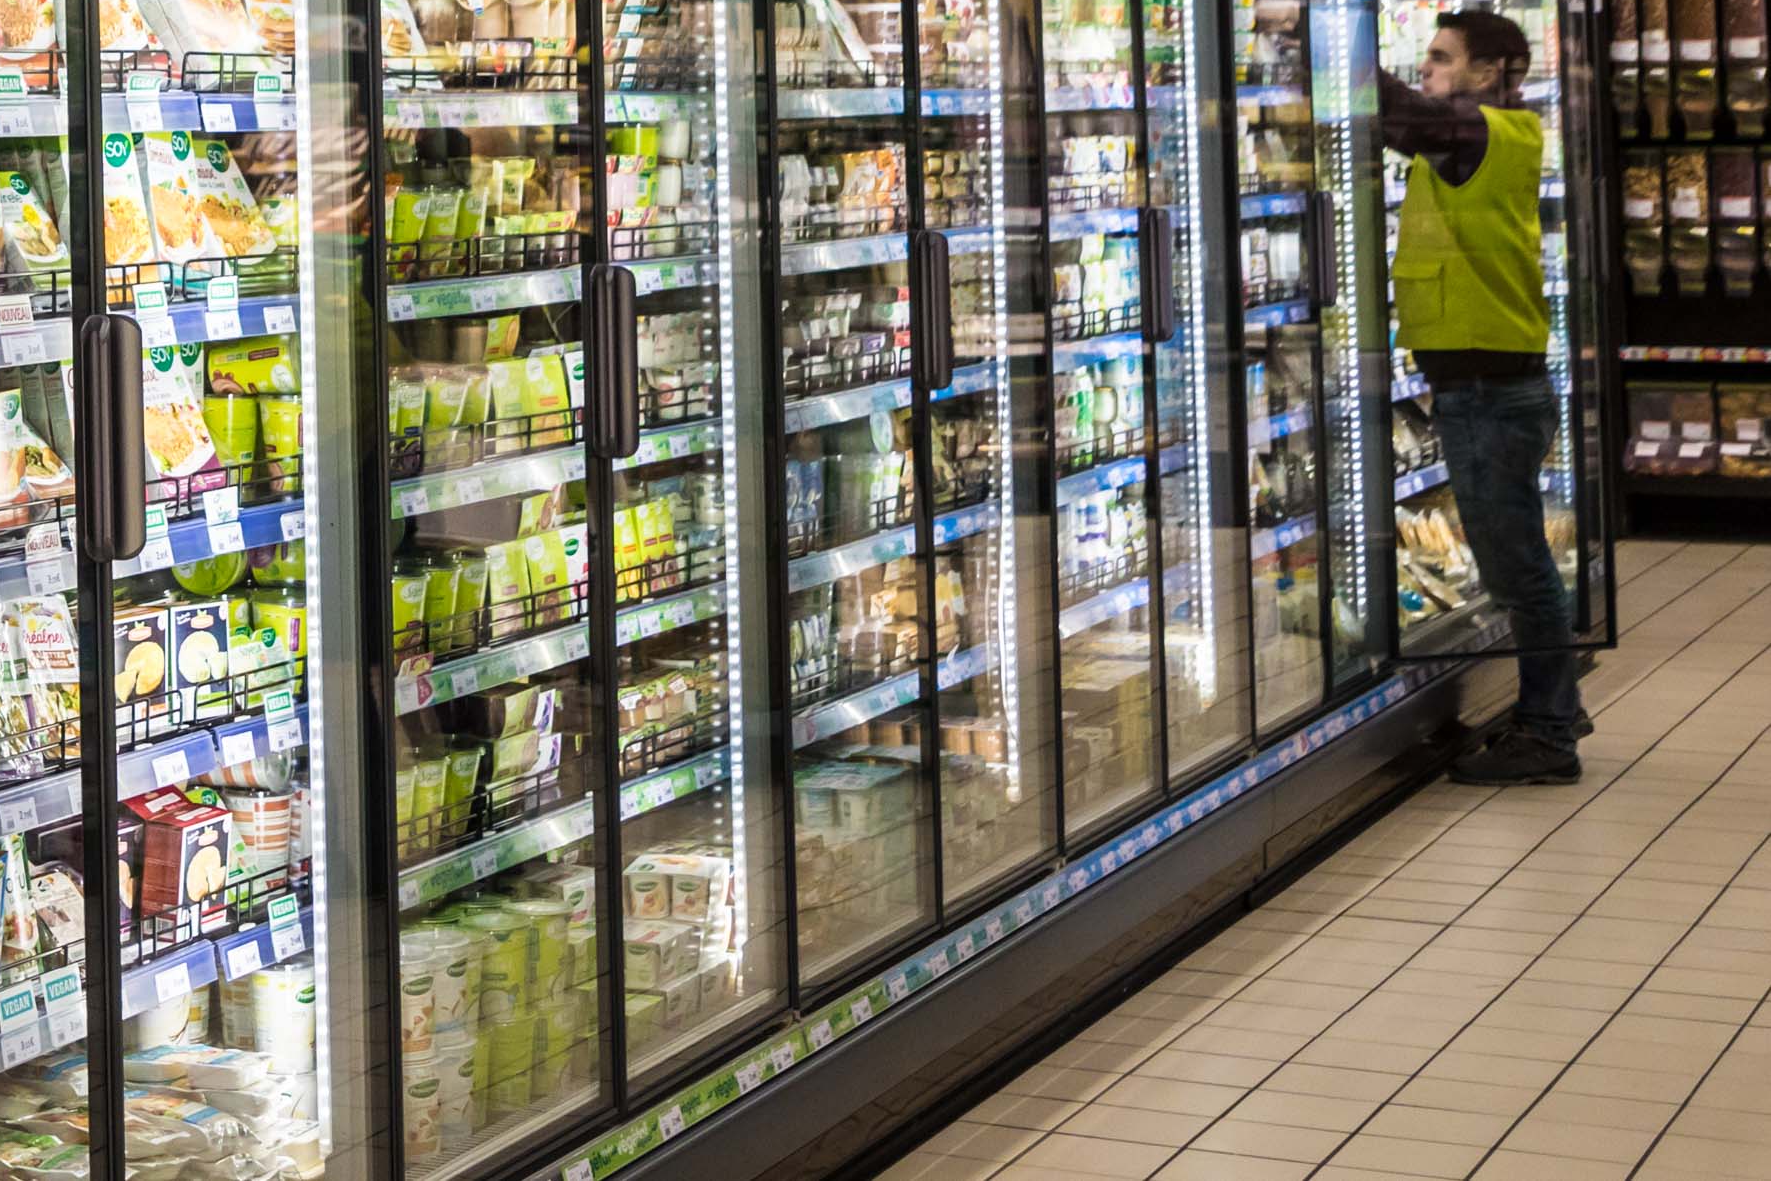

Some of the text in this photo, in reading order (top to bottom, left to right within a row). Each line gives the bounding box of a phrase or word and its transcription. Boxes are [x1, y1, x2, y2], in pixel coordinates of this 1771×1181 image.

[105, 141, 128, 157] SOY
[47, 976, 77, 999] VEGAN
[2, 992, 33, 1017] VEGAN
